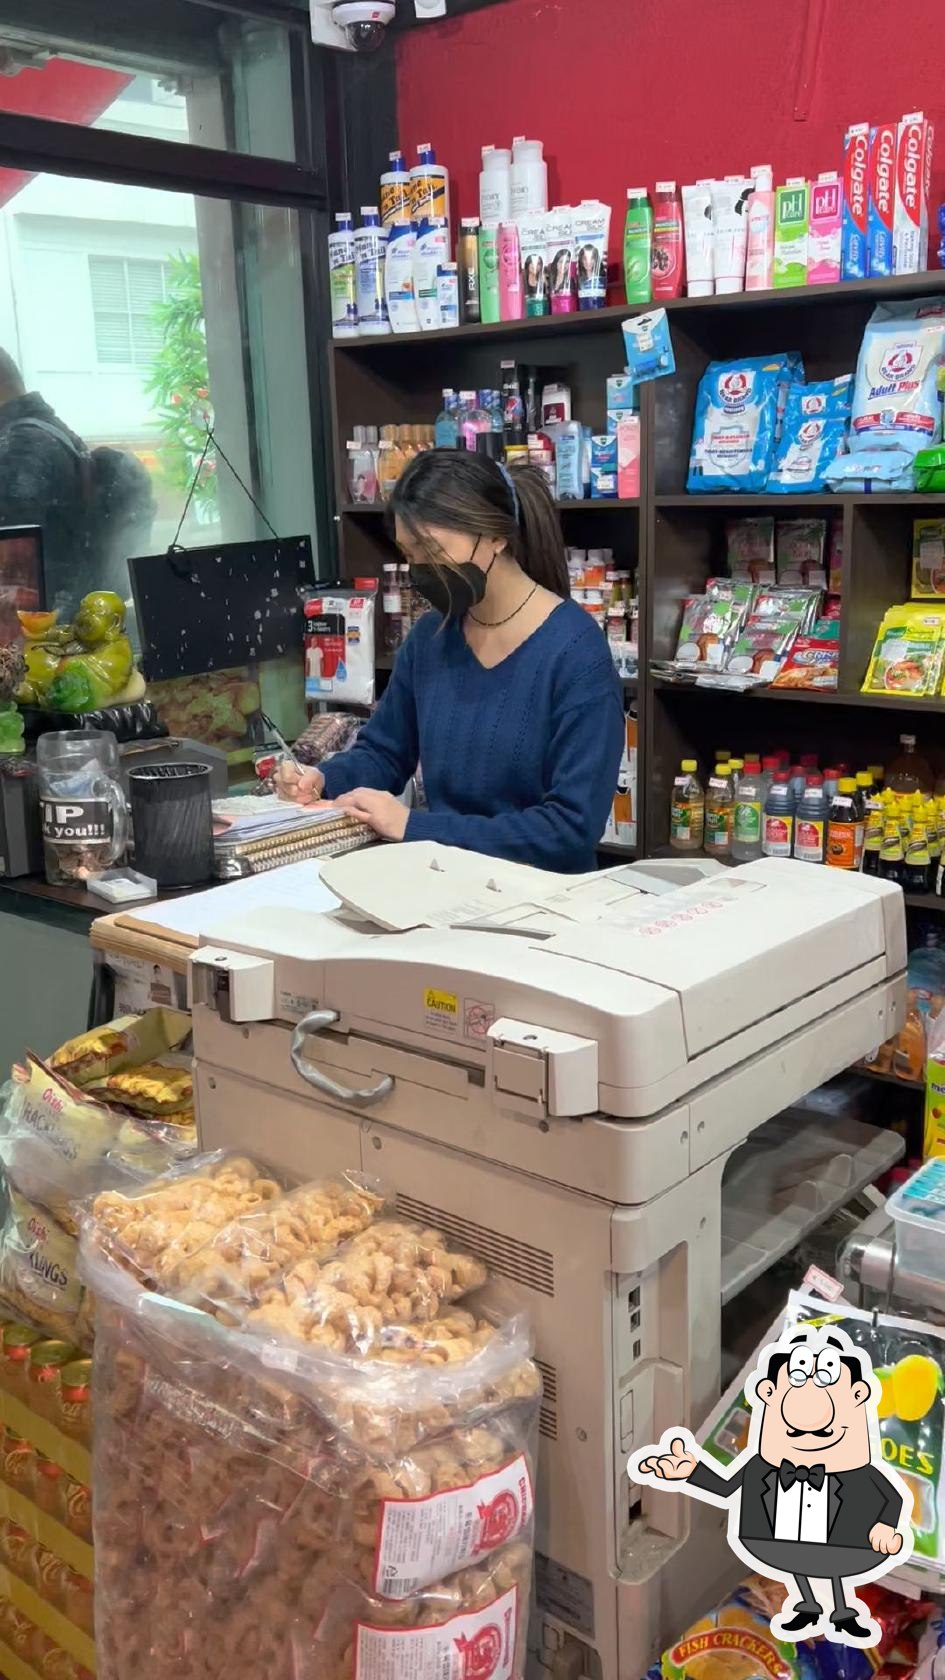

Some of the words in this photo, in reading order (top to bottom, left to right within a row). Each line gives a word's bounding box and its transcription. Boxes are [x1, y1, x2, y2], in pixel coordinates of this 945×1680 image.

[851, 135, 868, 215] Colgate
[877, 130, 894, 212] Colgate
[904, 125, 922, 208] Colgate
[521, 228, 545, 236] CREA
[869, 383, 897, 397] Adult
[898, 380, 920, 392] Plus
[307, 620, 313, 632] 3
[40, 802, 84, 824] IP
[54, 823, 105, 837] you!!!
[426, 998, 456, 1013] CAUTION
[29, 1251, 68, 1286] KLINGS
[881, 1437, 934, 1475] OES
[678, 1637, 709, 1658] FISH
[713, 1633, 783, 1676] CRACKERS
